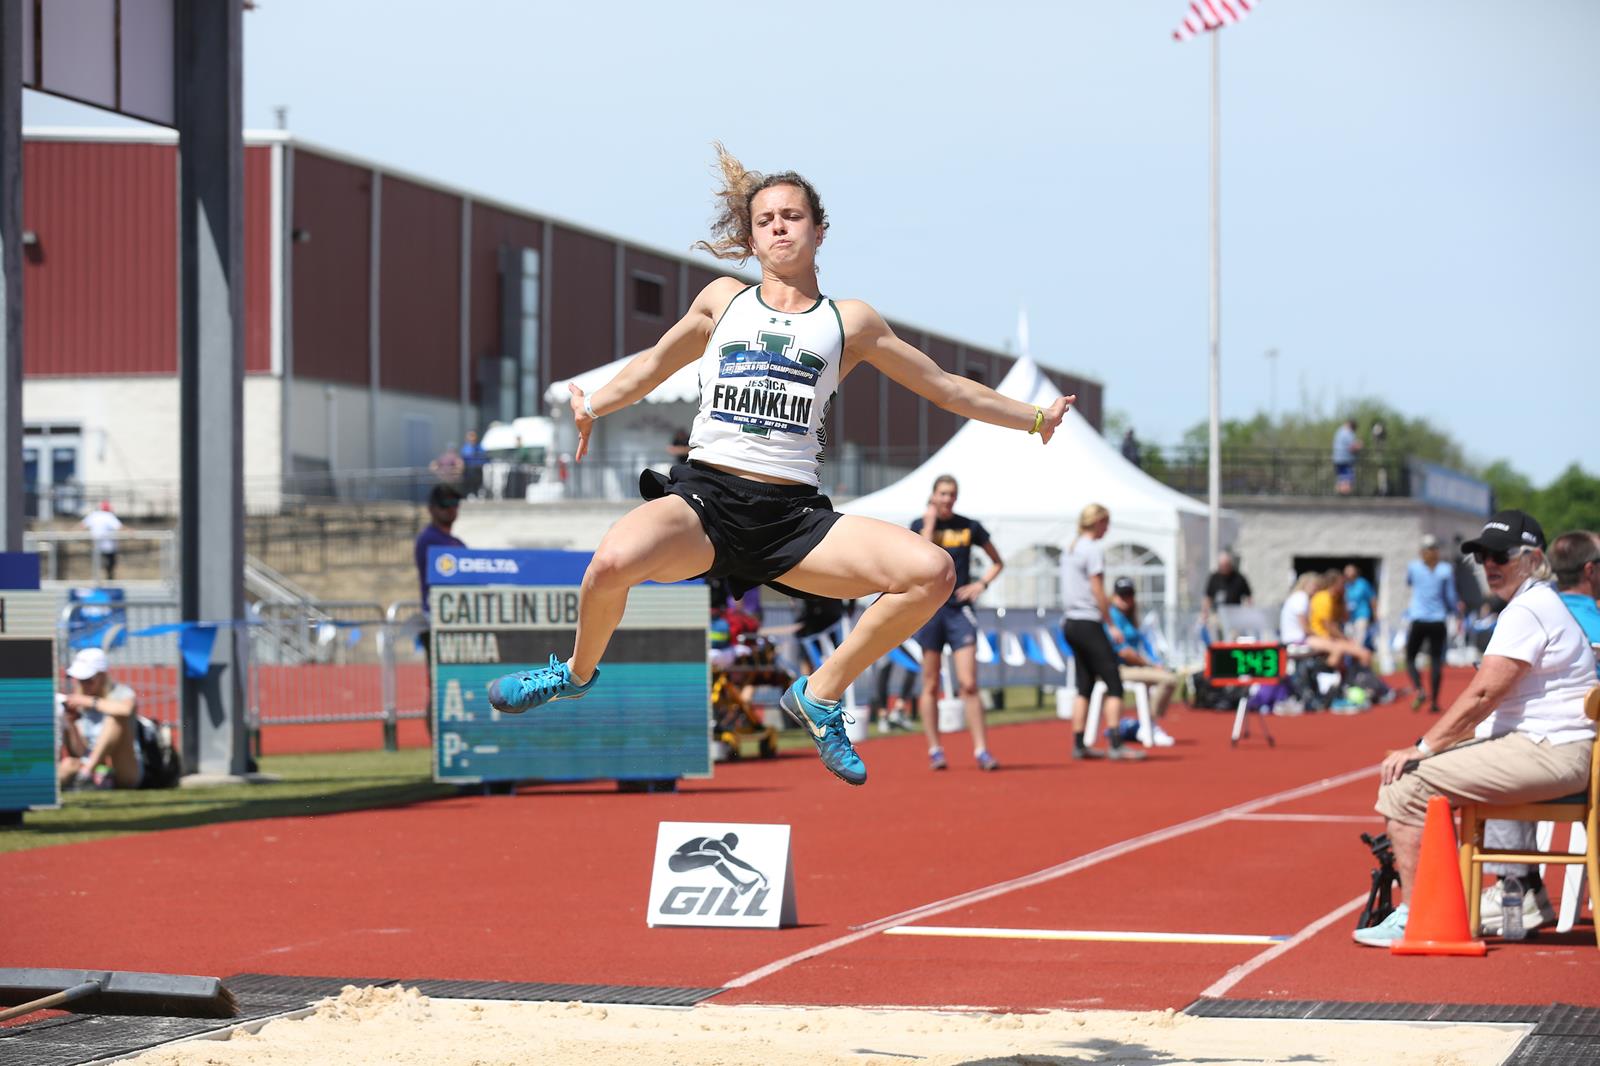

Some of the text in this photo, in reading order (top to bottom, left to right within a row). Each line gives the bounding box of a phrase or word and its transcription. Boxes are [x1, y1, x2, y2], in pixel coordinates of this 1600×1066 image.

[745, 379, 786, 391] JESSICA
[769, 363, 814, 379] CHAMPIONSHIPS
[712, 384, 813, 424] FRANKLIN
[458, 558, 519, 573] DELTA
[439, 592, 537, 624] CAITLIN
[442, 679, 474, 722] A:
[443, 733, 469, 768] P:
[659, 886, 771, 916] GILL
